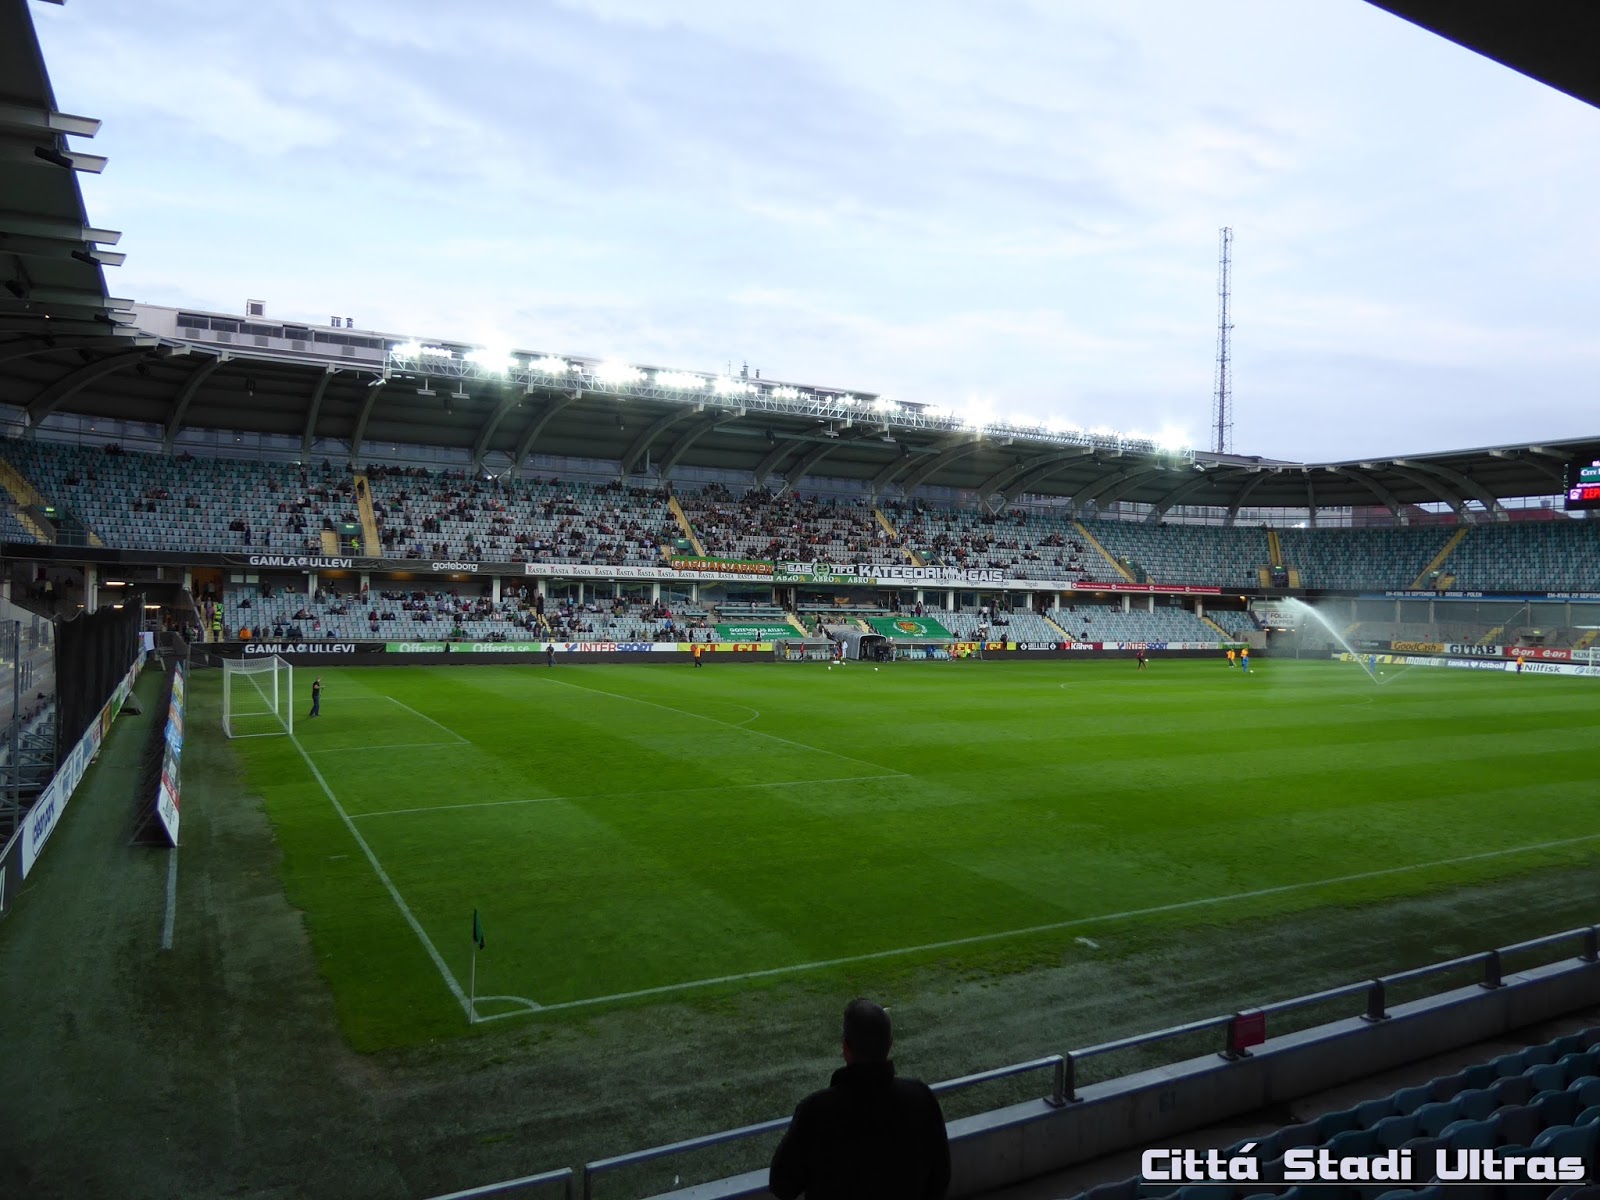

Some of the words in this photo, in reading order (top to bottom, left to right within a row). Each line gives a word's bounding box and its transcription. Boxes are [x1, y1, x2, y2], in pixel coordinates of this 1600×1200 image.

[250, 556, 297, 567] GAMLA
[309, 557, 353, 568] ULLEVI
[787, 565, 813, 573] GAIS
[831, 566, 855, 574] TIFO
[968, 570, 1004, 582] GAIS
[245, 643, 295, 654] GAMLA
[309, 643, 355, 653] ULLEVI
[580, 642, 654, 652] INTERSPORT
[690, 643, 720, 652] GT
[733, 643, 762, 652] GT
[1126, 642, 1169, 650] INTERSPORT
[1394, 641, 1437, 651] GoodCash
[1450, 644, 1497, 655] GITAB
[1479, 661, 1505, 669] fotboll
[1524, 664, 1561, 673] Nilfisk
